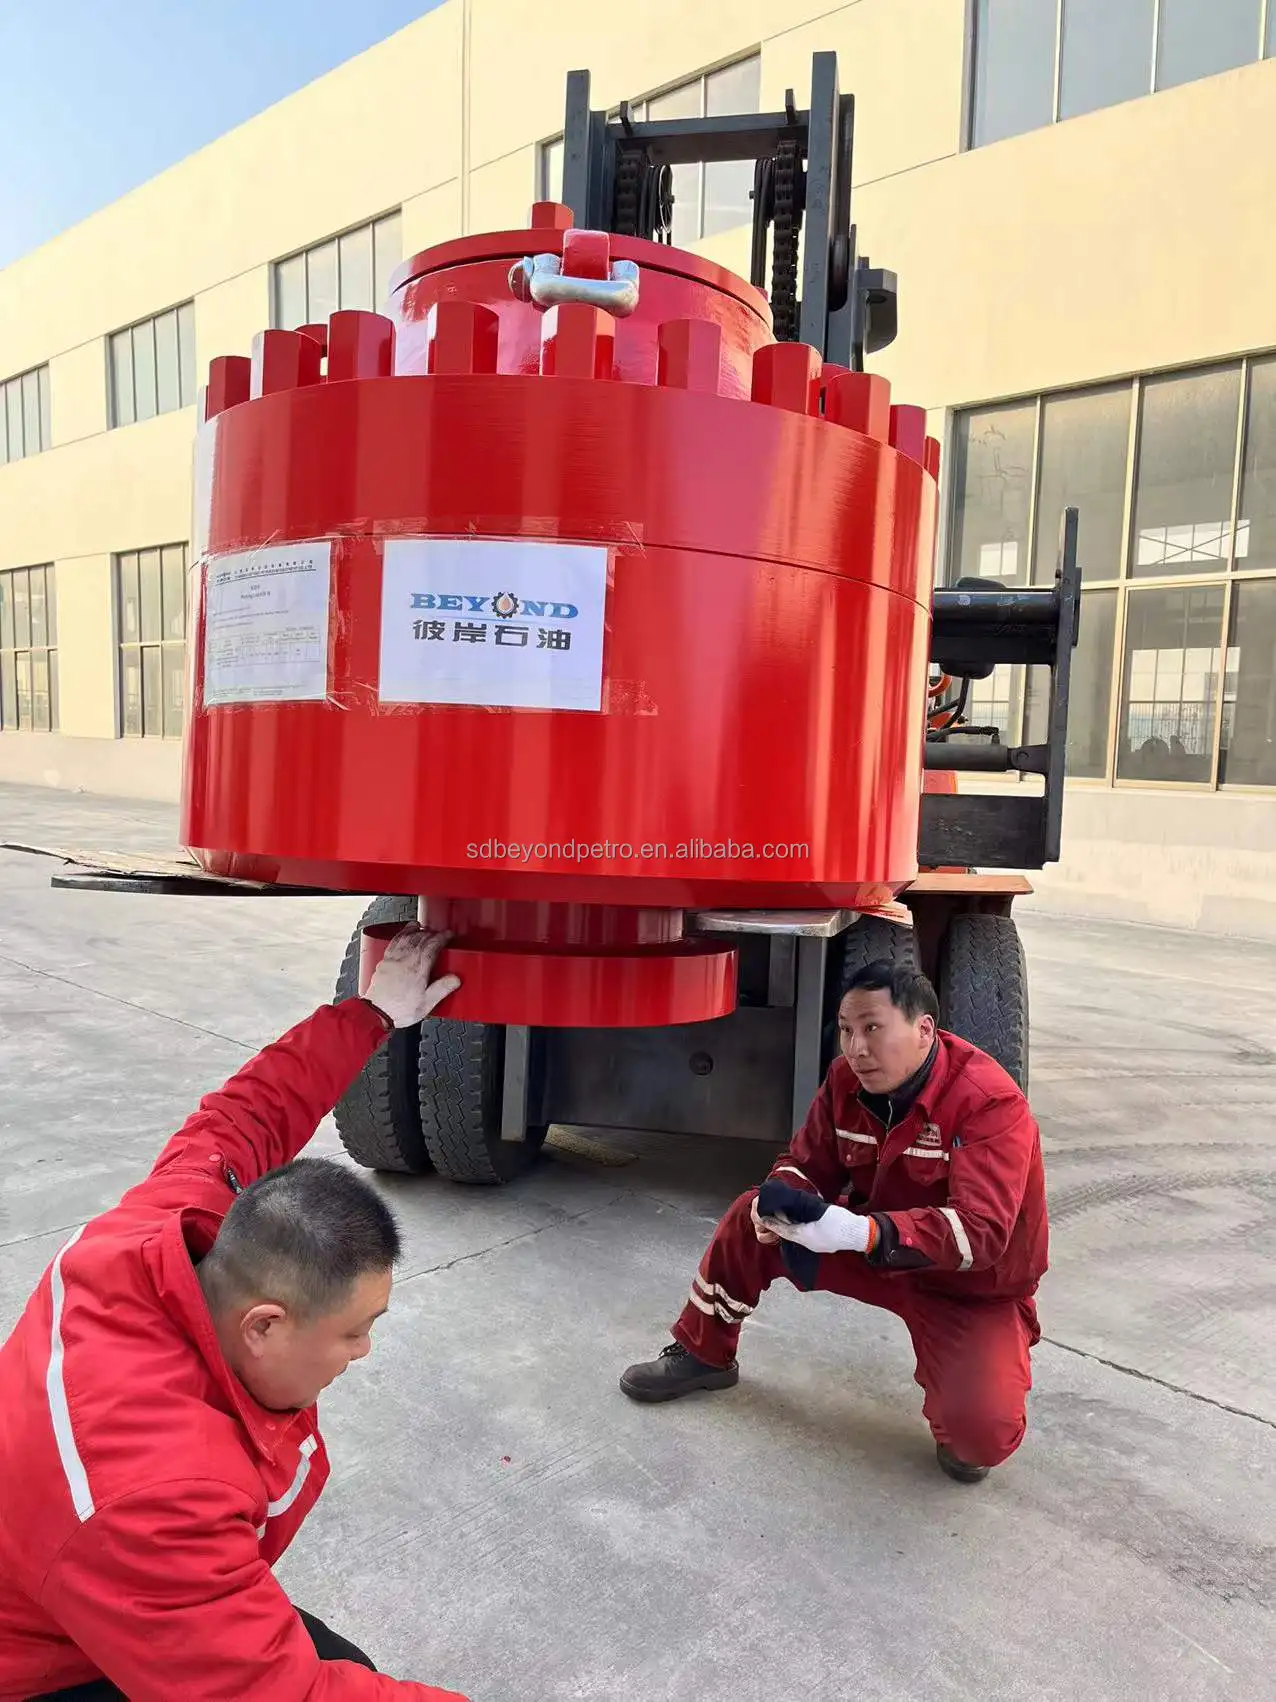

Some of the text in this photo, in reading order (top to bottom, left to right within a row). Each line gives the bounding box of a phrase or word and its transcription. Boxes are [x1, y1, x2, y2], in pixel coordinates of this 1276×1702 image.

[411, 592, 579, 619] BEYOND
[413, 619, 571, 650] 彼岸石油
